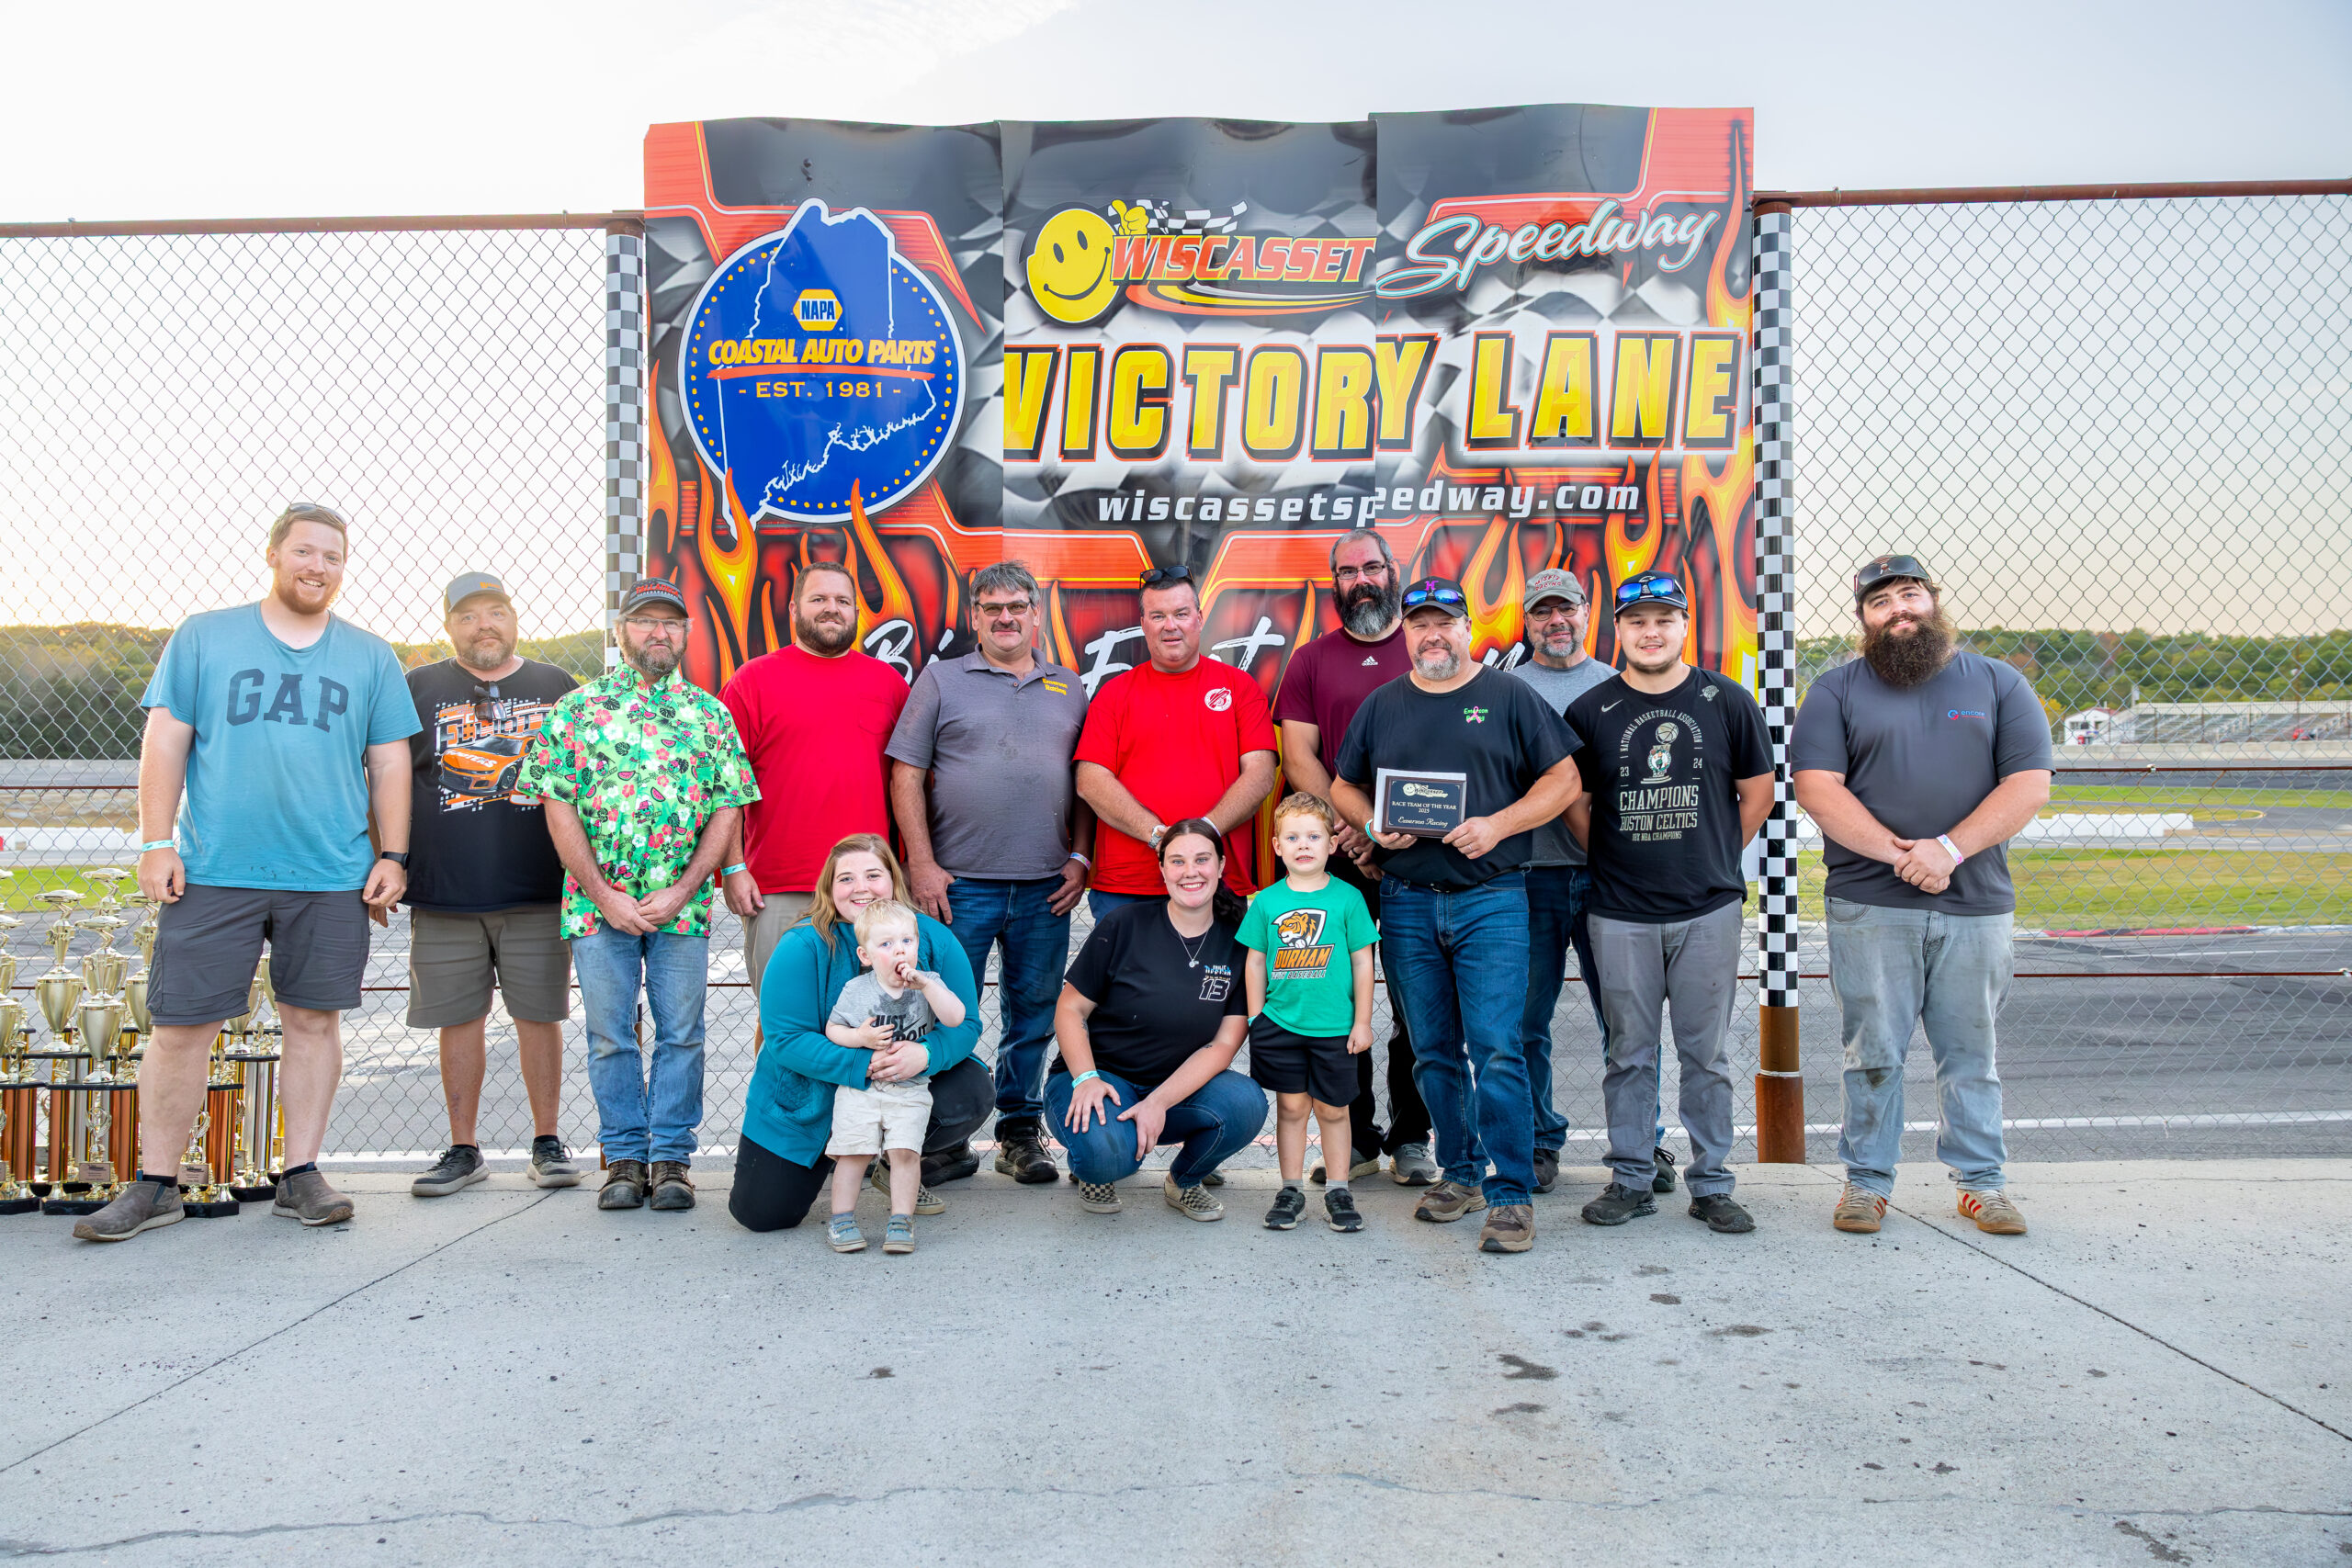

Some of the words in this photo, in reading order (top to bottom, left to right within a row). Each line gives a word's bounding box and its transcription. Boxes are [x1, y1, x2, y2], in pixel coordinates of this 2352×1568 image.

[1110, 235, 1377, 283] WISCASSET
[1376, 198, 1720, 299] Speedway
[801, 300, 835, 320] NAPA
[708, 338, 798, 365] COASTAL
[800, 338, 864, 364] AUTO
[866, 339, 936, 365] PARTS
[756, 381, 813, 398] EST.
[826, 381, 883, 398] 1981
[1003, 333, 1441, 462] VICTORY
[1466, 330, 1742, 450] LANE
[1098, 479, 1640, 527] wiscassetspeedway.com
[636, 583, 679, 597] TALLADEGA
[226, 668, 349, 733] GAP
[1620, 723, 1637, 752] NATIONAL
[1634, 709, 1677, 726] BASKETBALL
[1677, 712, 1702, 743] ASSOCIATION
[1620, 766, 1630, 777] 23
[1693, 758, 1702, 769] 24
[1620, 785, 1699, 811] CHAMPIONS
[1397, 816, 1425, 825] Emerson
[1425, 818, 1449, 828] Racing
[1620, 815, 1654, 831] BOSTON
[1656, 812, 1698, 830] CELTICS
[1641, 832, 1651, 841] NBA
[1652, 831, 1682, 840] CHAMPIONS
[1274, 948, 1331, 969] DURHAM
[1287, 969, 1327, 980] BASEBALL
[1199, 978, 1230, 1001] 13
[870, 1014, 907, 1031] JUST
[919, 1023, 928, 1038] IT
